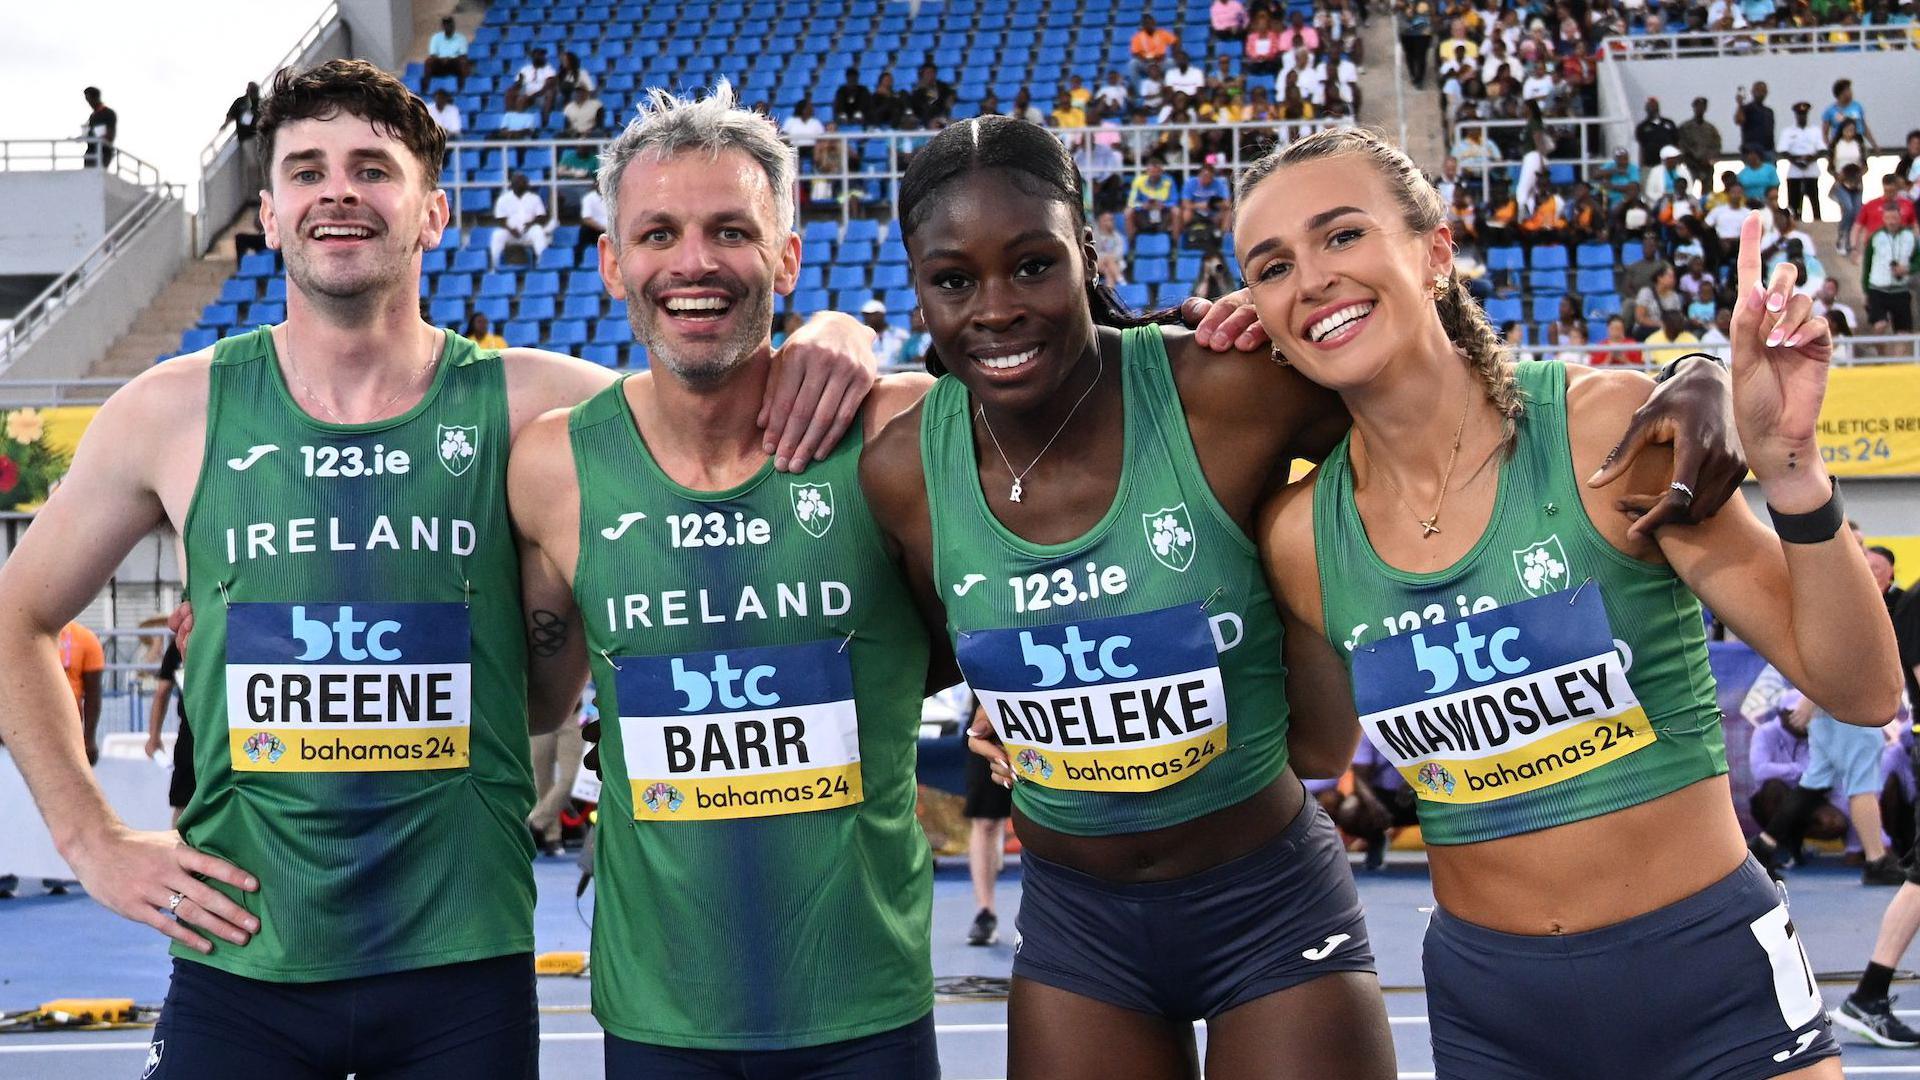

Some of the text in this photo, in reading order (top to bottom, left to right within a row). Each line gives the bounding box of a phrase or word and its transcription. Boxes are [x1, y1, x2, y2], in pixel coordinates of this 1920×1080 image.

[301, 445, 410, 477] 123.ie
[226, 516, 476, 563] IRELAND
[666, 513, 771, 547] 123.ie
[607, 582, 851, 631] IRELAND
[1008, 562, 1128, 612] 123.ie
[292, 606, 402, 661] btc
[1018, 626, 1139, 687] btc
[1411, 622, 1531, 694] btc
[246, 673, 452, 723] GREENE
[670, 655, 781, 712] btc
[997, 680, 1213, 746] ADELEKE
[1376, 663, 1616, 760] MAWDSLEY
[301, 736, 455, 761] bahamas24
[663, 716, 810, 773] BARR
[1063, 741, 1215, 781] bahamas24
[1464, 722, 1634, 792] bahamas24
[696, 776, 850, 809] bahamas24
